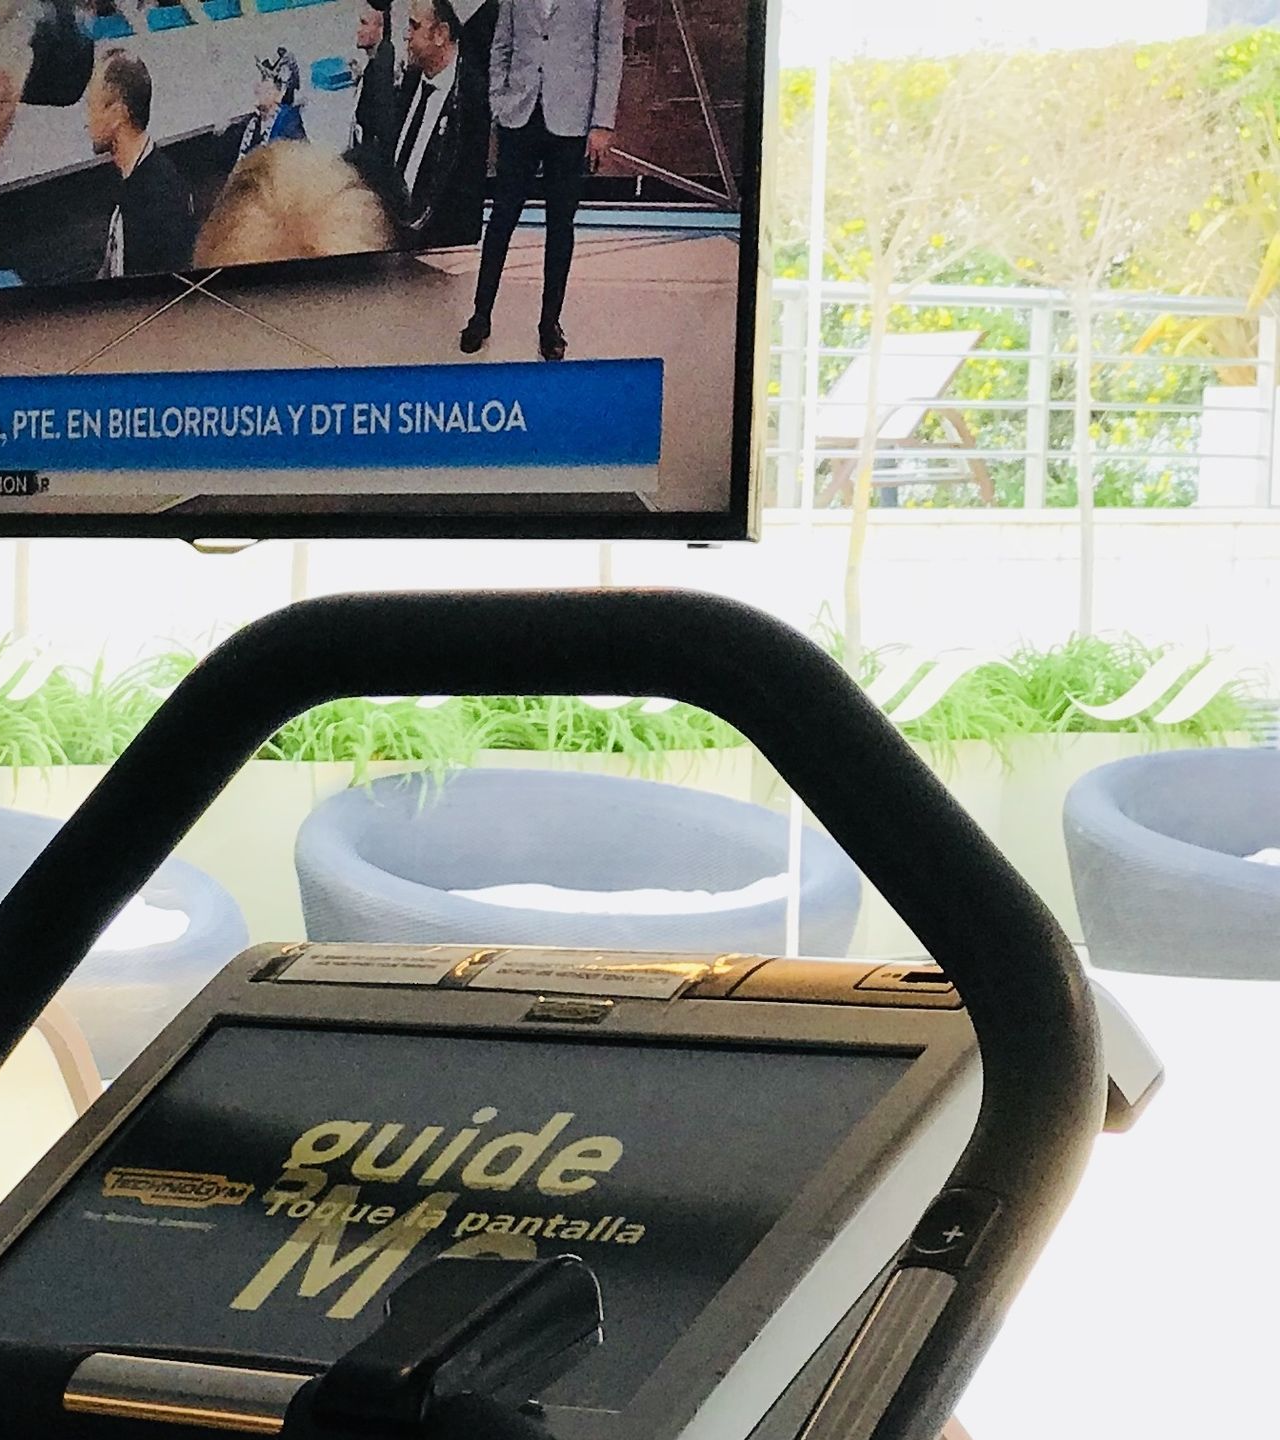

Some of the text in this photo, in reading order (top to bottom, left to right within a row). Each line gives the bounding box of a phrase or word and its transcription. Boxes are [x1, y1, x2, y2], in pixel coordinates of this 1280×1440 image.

[11, 408, 61, 441] PTE.
[66, 407, 102, 440] EN
[107, 404, 283, 440] BIELORRUSIA
[287, 403, 306, 437] Y
[310, 402, 347, 436] DT
[351, 401, 391, 436] EN
[397, 399, 528, 435] SINALOA
[263, 1106, 624, 1205] guide
[266, 1192, 647, 1246] Toque la pantalla
